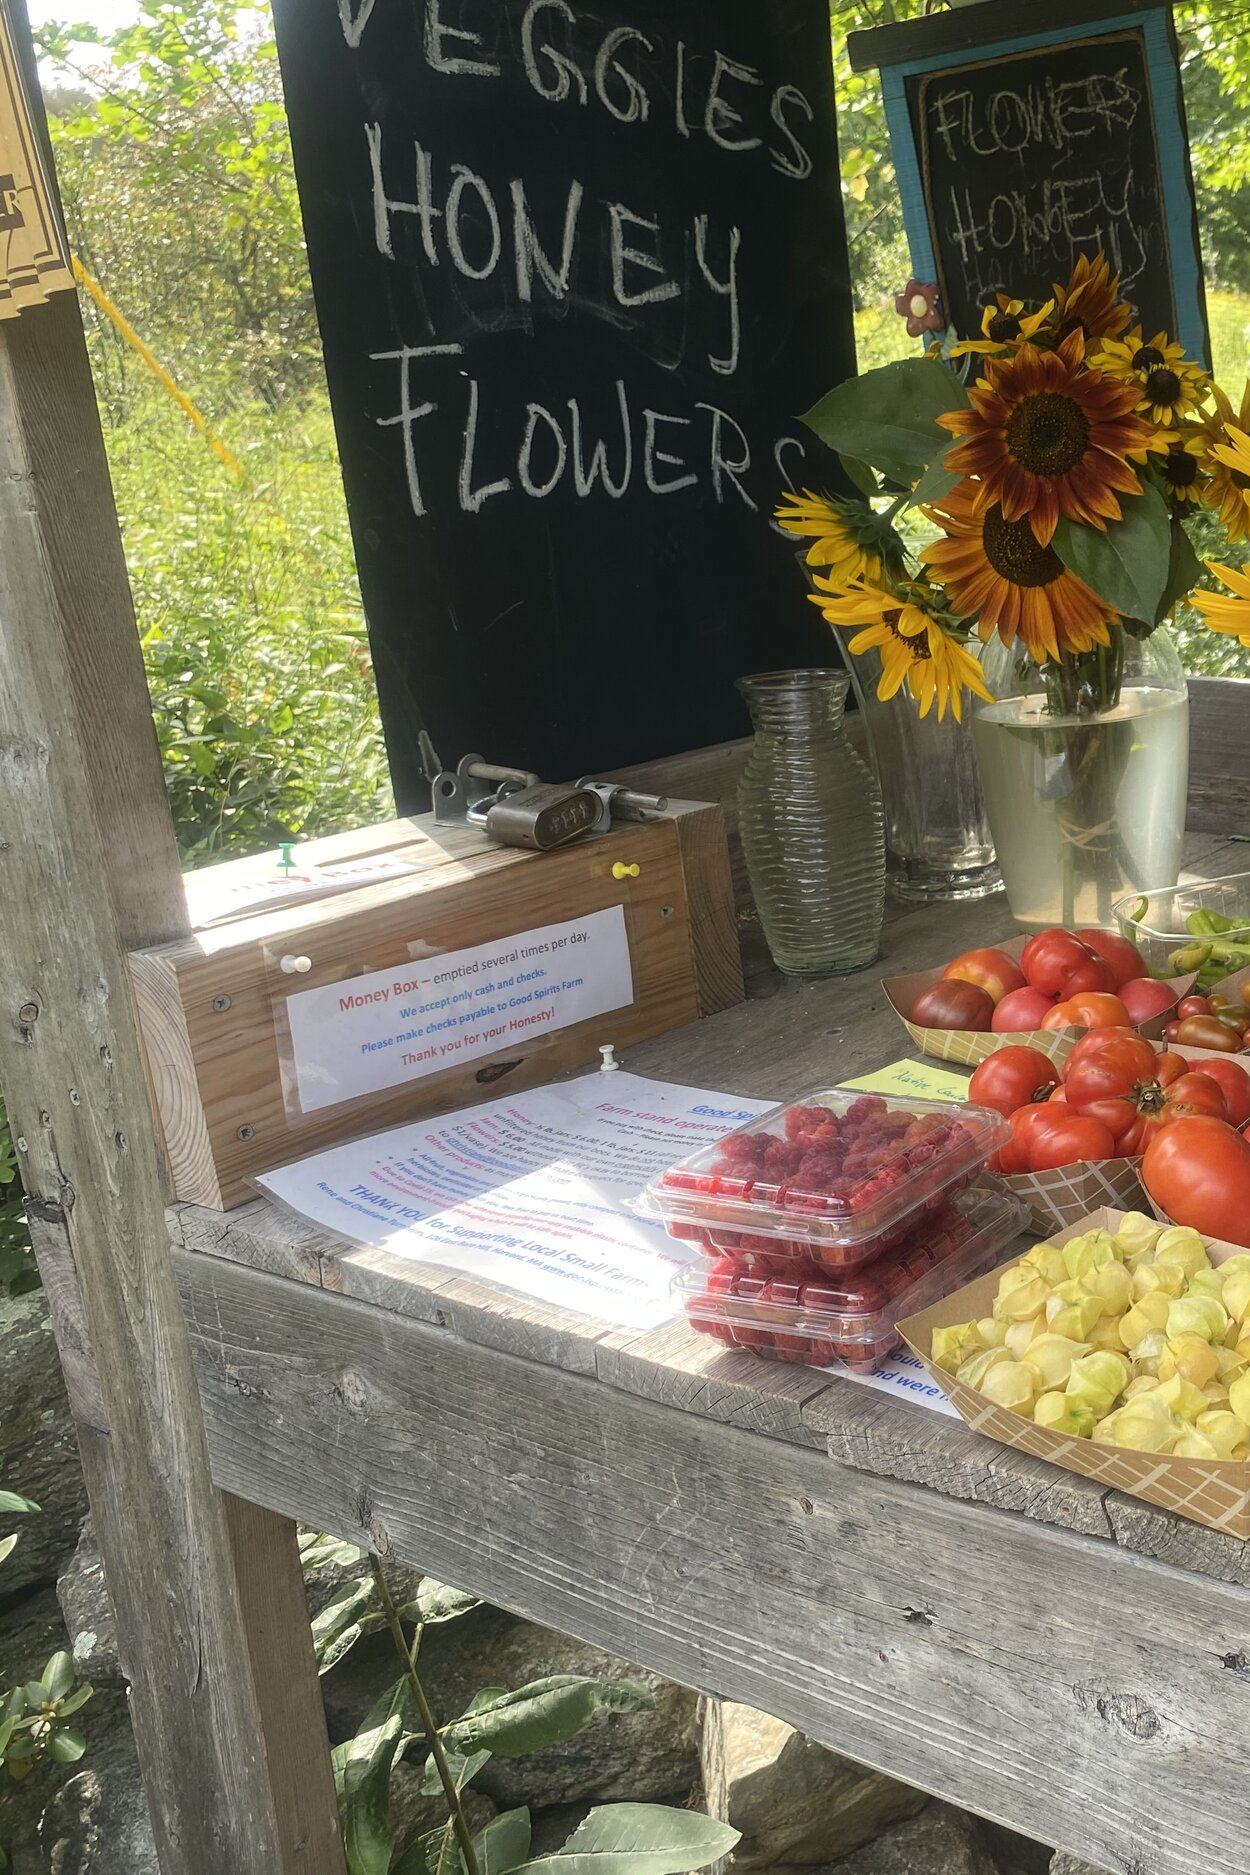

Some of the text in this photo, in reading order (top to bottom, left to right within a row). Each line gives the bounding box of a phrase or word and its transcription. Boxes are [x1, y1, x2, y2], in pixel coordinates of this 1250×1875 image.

[364, 123, 742, 374] HONEY
[369, 344, 806, 540] FLOWERS
[339, 931, 591, 1012] Money Box emptied several times per day.
[400, 968, 547, 1019] We accept only cash and checks.
[361, 977, 584, 1054] Please make checks payable to Good Spirits Farm
[401, 1006, 555, 1066] Thank you for your Honesty!
[595, 1103, 633, 1115] Farm
[632, 1113, 678, 1124] stand
[691, 1105, 733, 1118] Good
[425, 1135, 449, 1152] Other
[318, 1182, 337, 1197] Rene
[336, 1197, 355, 1205] and
[350, 1184, 400, 1210] THANK
[396, 1207, 431, 1221] YOU
[427, 1219, 451, 1229] for
[448, 1226, 525, 1247] Supporting
[521, 1241, 565, 1257] Local
[560, 1253, 607, 1272] Small
[896, 1376, 940, 1397] were
